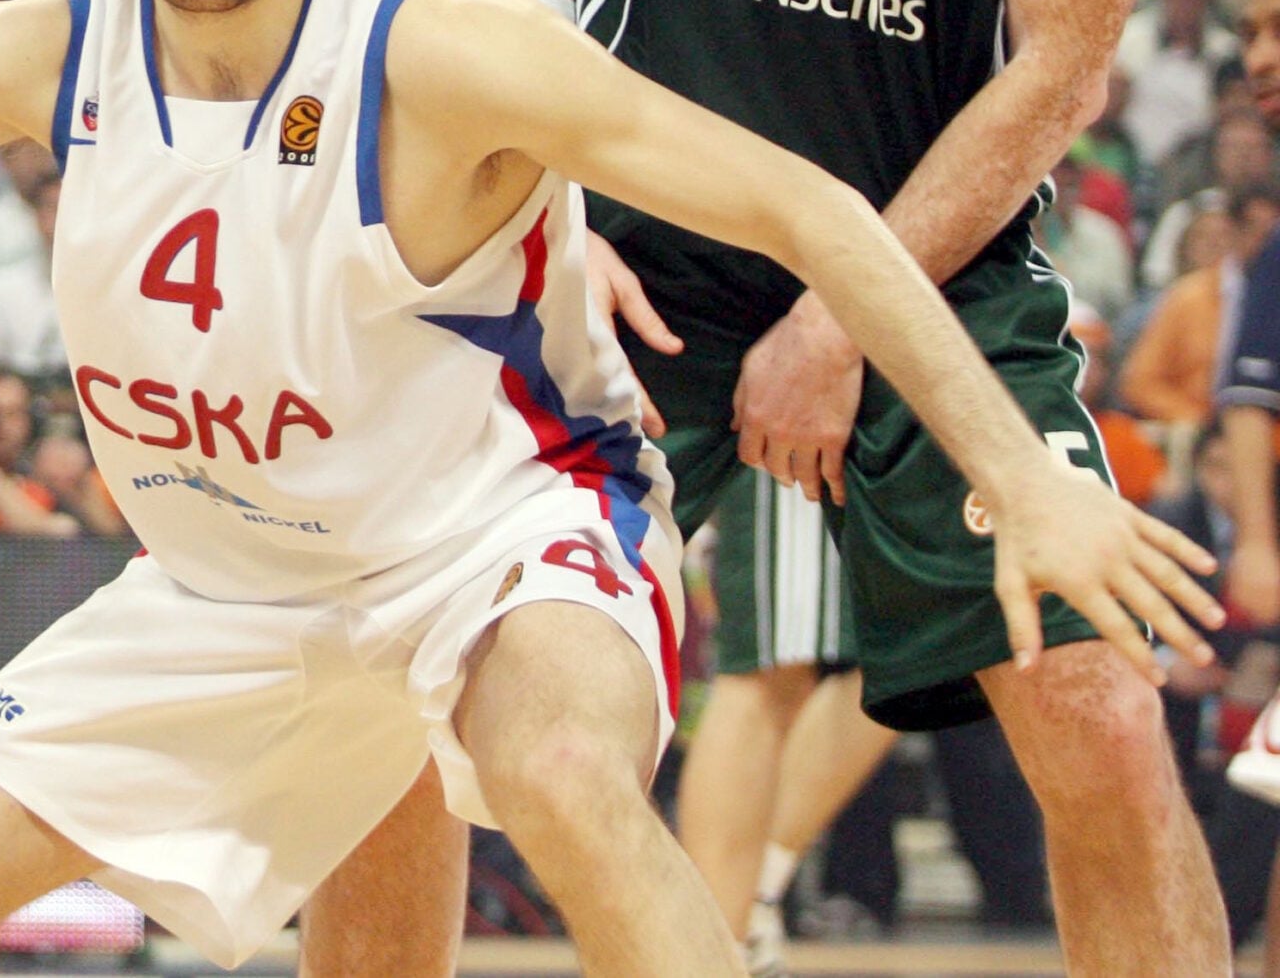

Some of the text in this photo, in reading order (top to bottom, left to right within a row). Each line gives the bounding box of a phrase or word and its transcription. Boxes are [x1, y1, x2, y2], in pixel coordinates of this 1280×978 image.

[139, 208, 224, 333] 4
[76, 365, 334, 465] CSKA
[540, 539, 634, 599] 4
